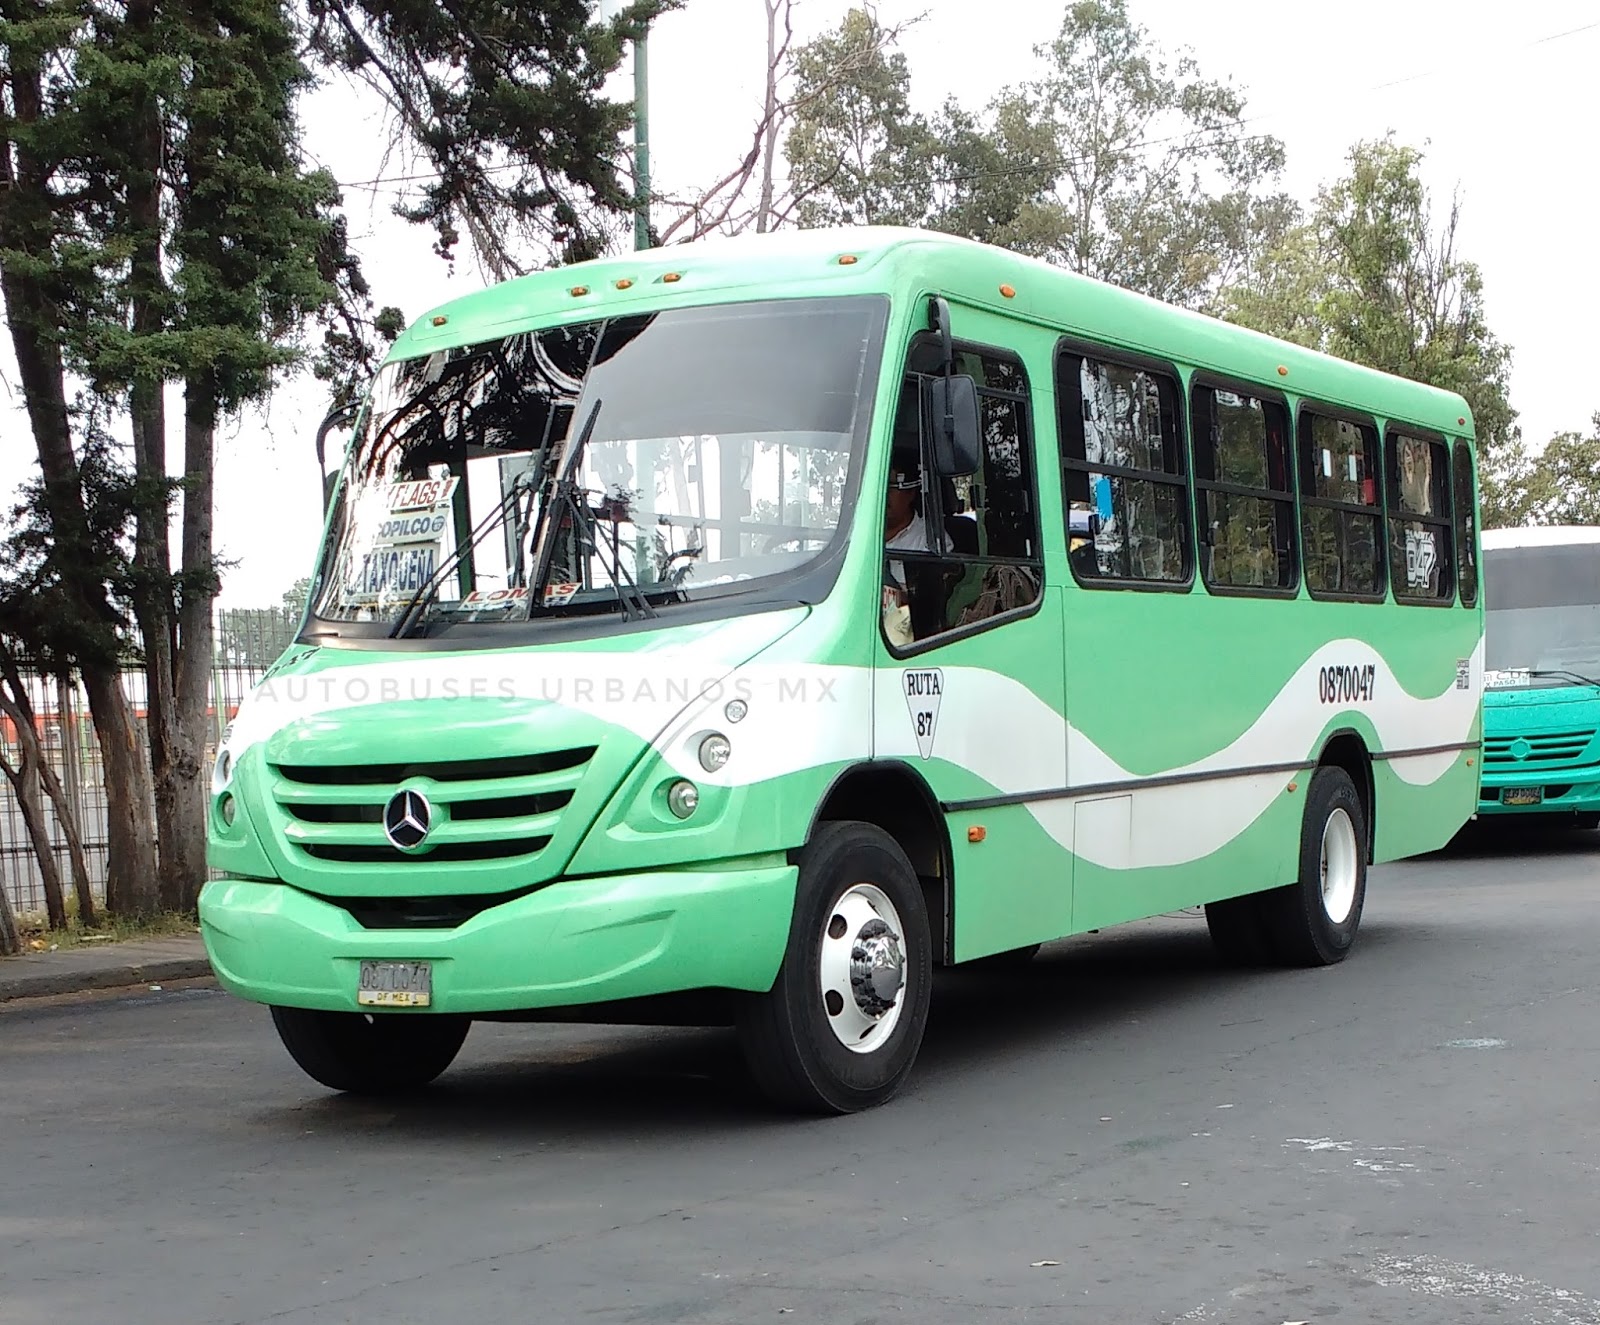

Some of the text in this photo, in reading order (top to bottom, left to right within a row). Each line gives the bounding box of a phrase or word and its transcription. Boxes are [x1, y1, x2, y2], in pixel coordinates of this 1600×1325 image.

[378, 517, 431, 539] OPILCO
[907, 673, 941, 696] RUTA
[1319, 664, 1375, 704] 0870047
[917, 710, 933, 737] 87
